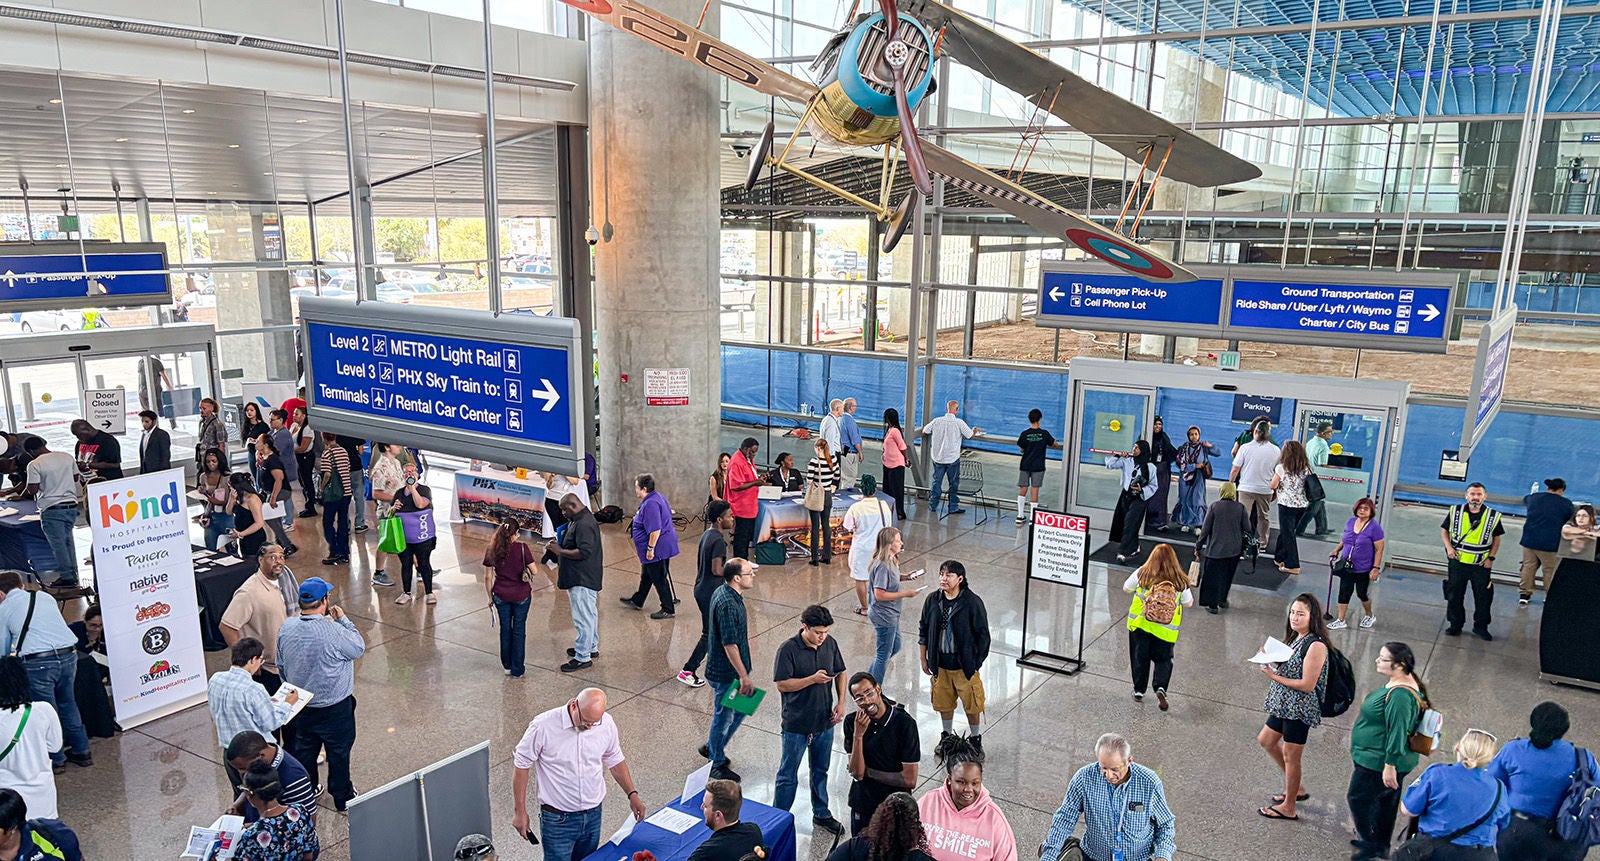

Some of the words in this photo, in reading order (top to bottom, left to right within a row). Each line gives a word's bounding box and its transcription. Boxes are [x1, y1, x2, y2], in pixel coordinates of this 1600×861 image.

[1085, 285, 1130, 297] Passenger
[1131, 287, 1167, 299] Pick-Up
[1281, 286, 1318, 297] Ground
[1320, 288, 1395, 301] Transportation
[1084, 298, 1100, 307] Cell
[1102, 299, 1130, 309] Phone
[1131, 300, 1147, 310] Lot
[1235, 299, 1257, 309] Ride
[1258, 300, 1287, 310] Share
[1293, 302, 1318, 312] Uber
[1325, 303, 1345, 315] Lyft
[1352, 305, 1392, 316] Waymo
[1299, 317, 1338, 328] Charter
[1345, 319, 1367, 331] City
[1369, 321, 1390, 331] Bus
[329, 332, 359, 351] Level
[361, 336, 370, 352] 2
[390, 339, 437, 360] METRO
[440, 345, 473, 367] Light
[475, 349, 502, 368] Rail
[1220, 353, 1238, 367] EXIT
[336, 359, 366, 378] Level
[368, 364, 376, 379] 3
[397, 368, 424, 386] PHX
[425, 371, 448, 393] Sky
[450, 375, 481, 394] Train
[483, 380, 501, 397] to:
[91, 399, 119, 407] Closed
[319, 383, 369, 404] Terminals
[388, 393, 394, 408] /
[395, 394, 433, 415] Rental
[435, 400, 457, 418] Car
[459, 404, 502, 425] Center
[1243, 402, 1271, 413] Parking
[1035, 512, 1087, 531] NOTICE
[109, 520, 175, 539] HOSPITALITY
[1055, 531, 1083, 540] Customers
[111, 541, 135, 551] Proud
[147, 530, 185, 543] Represent
[1042, 535, 1069, 544] Employees
[1070, 539, 1082, 547] Only
[1038, 549, 1062, 557] Employee
[1063, 553, 1079, 561] Badge
[1058, 546, 1077, 554] Display
[125, 549, 169, 568] Panera
[1047, 559, 1077, 569] Trespassing
[1038, 563, 1055, 571] Strictly
[1055, 566, 1079, 575] Enforced
[130, 573, 168, 590] native
[150, 633, 163, 649] B
[123, 673, 201, 703] www.KindHospitality.com
[945, 829, 959, 839] THE
[959, 833, 991, 848] REASON
[934, 834, 978, 859] SMILE
